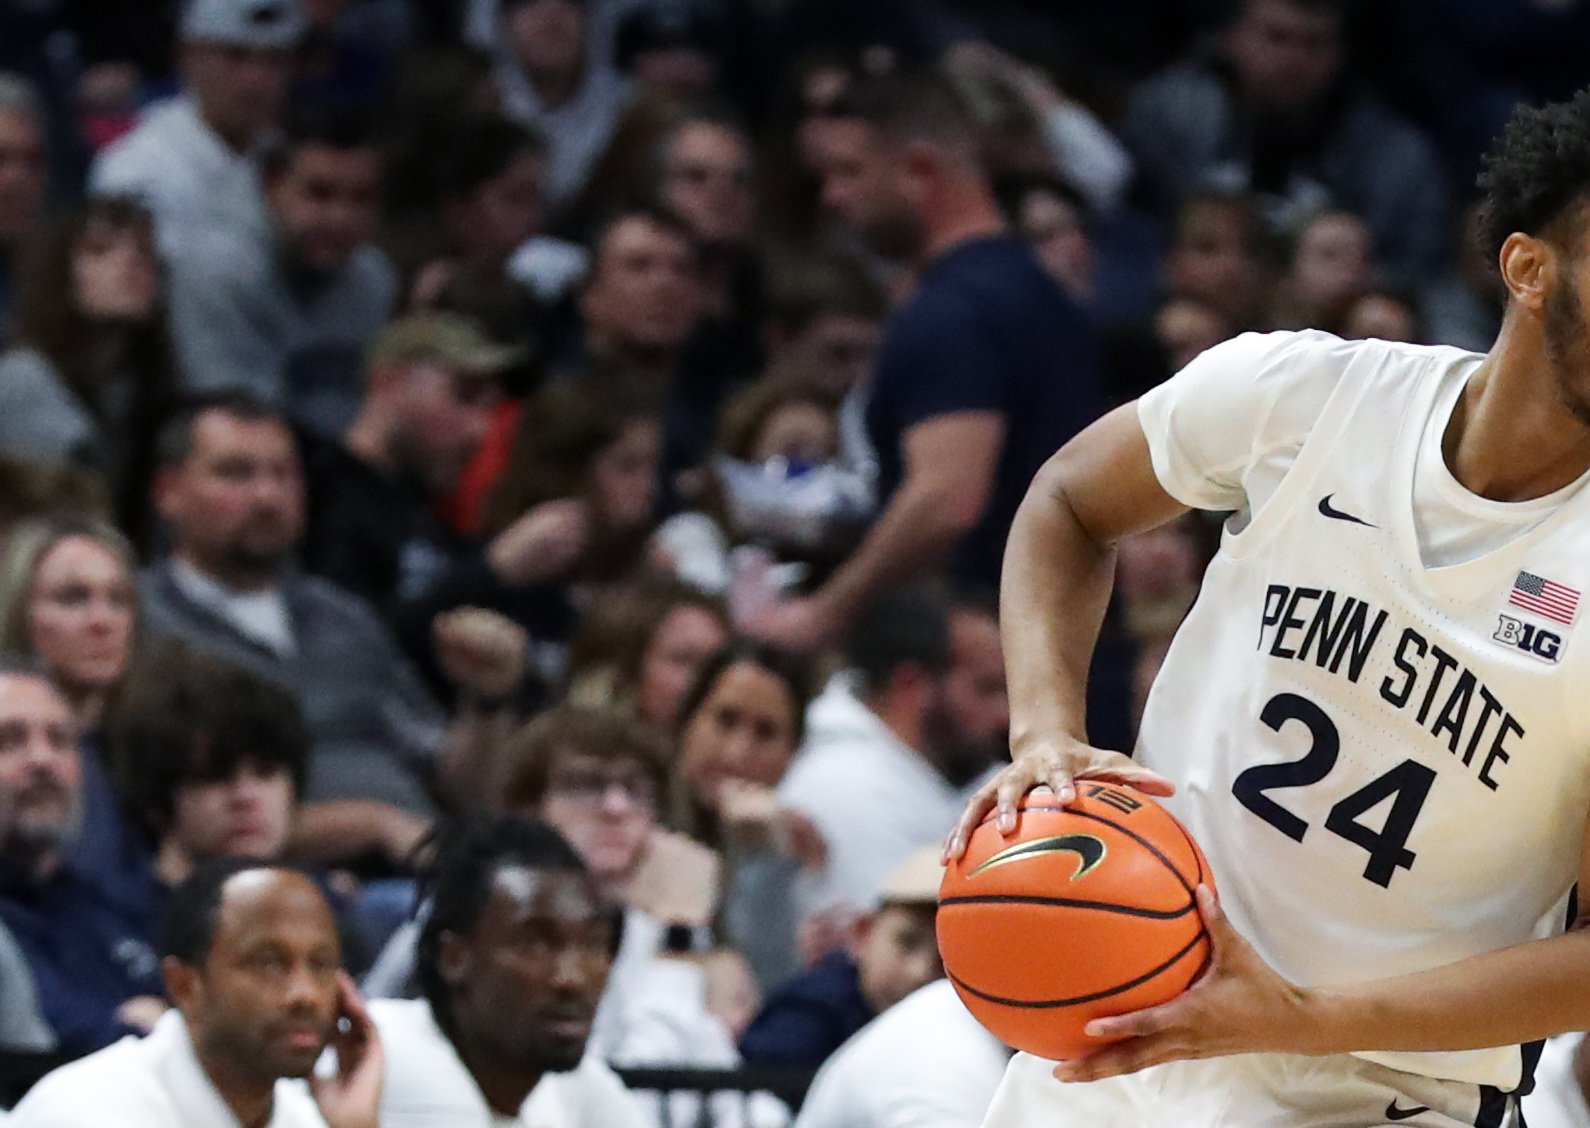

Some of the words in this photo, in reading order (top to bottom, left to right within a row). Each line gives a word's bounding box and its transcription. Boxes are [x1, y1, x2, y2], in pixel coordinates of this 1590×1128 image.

[1258, 584, 1389, 684] PENN
[1379, 627, 1526, 792] STATE
[1231, 692, 1438, 889] 24
